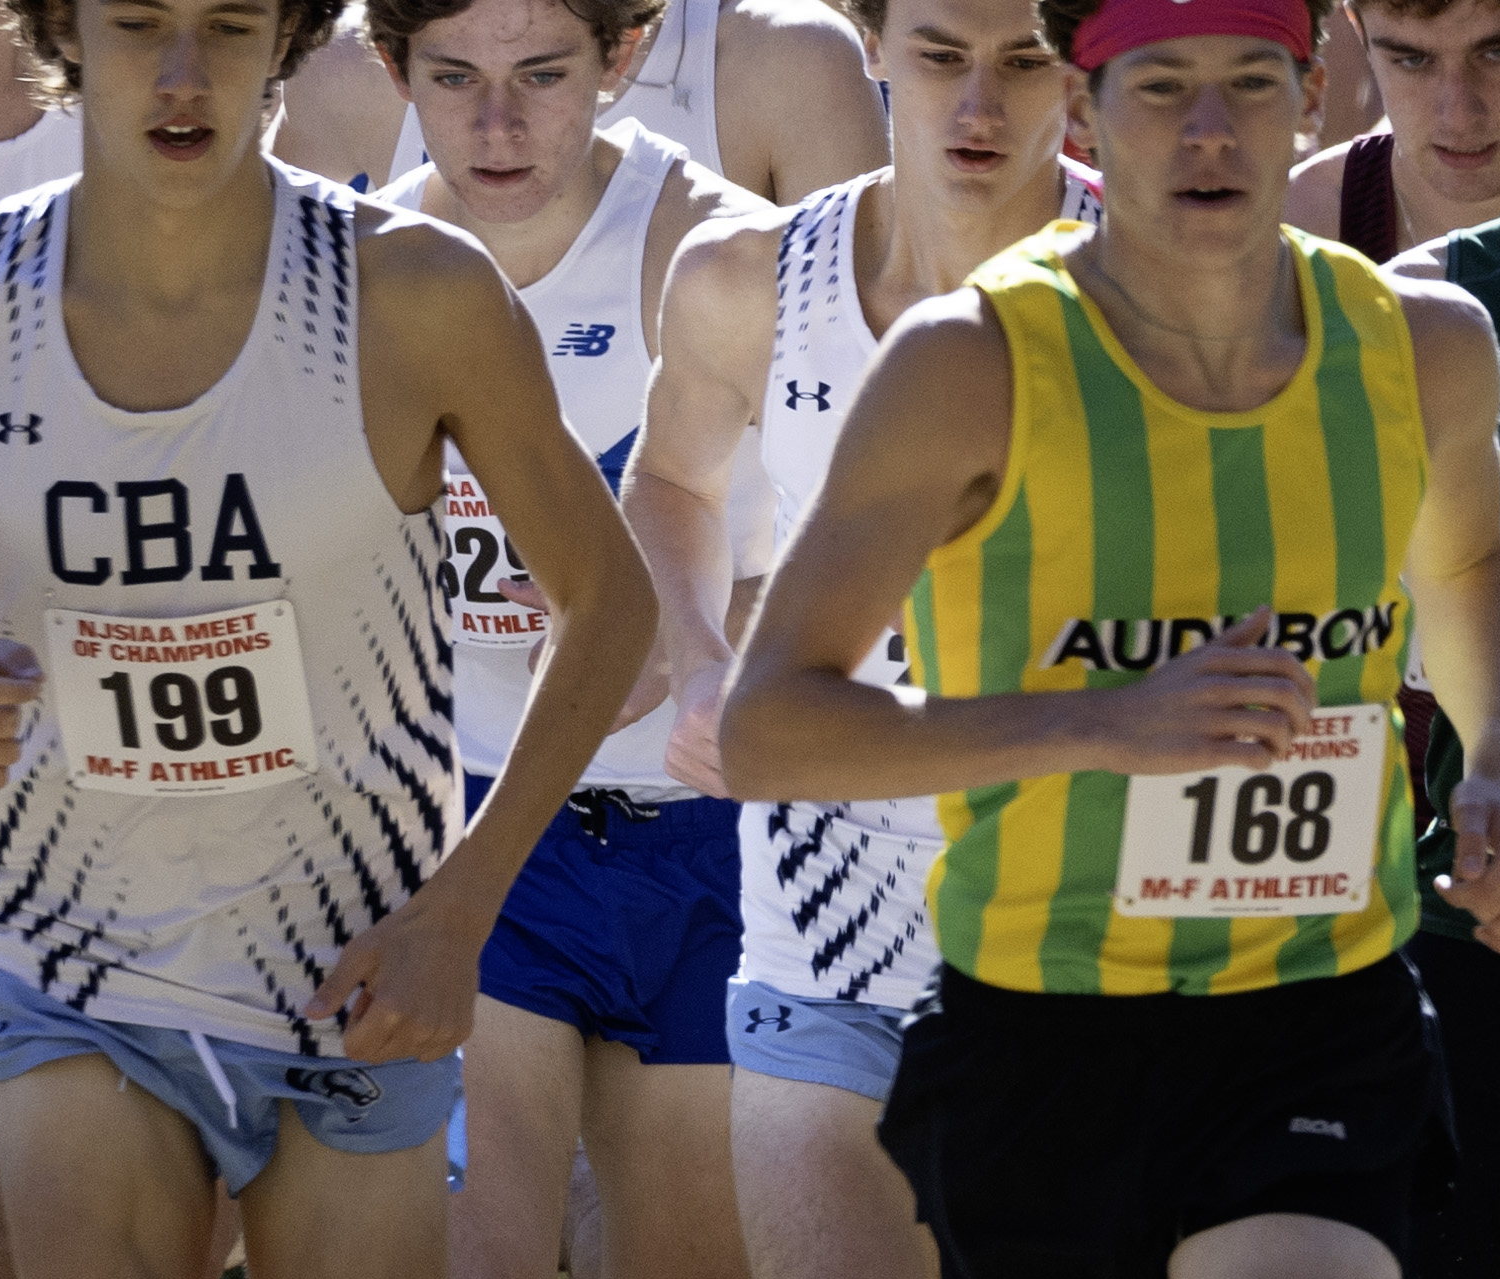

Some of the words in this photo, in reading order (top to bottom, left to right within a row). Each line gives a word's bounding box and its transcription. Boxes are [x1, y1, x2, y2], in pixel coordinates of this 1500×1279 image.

[45, 473, 281, 586] CBA
[76, 618, 180, 644] NJSIAA
[185, 612, 258, 642] MEET
[462, 611, 550, 635] ATHLE
[1040, 602, 1398, 670] AUDBON
[72, 637, 106, 658] OF
[109, 631, 272, 664] CHAMPIONS
[97, 665, 264, 753] 199
[86, 752, 139, 781] M-F
[149, 747, 295, 784] ATHLETIC
[1182, 770, 1337, 866] 168
[1140, 875, 1202, 901] M-F
[1209, 873, 1349, 901] ATHLETIC
